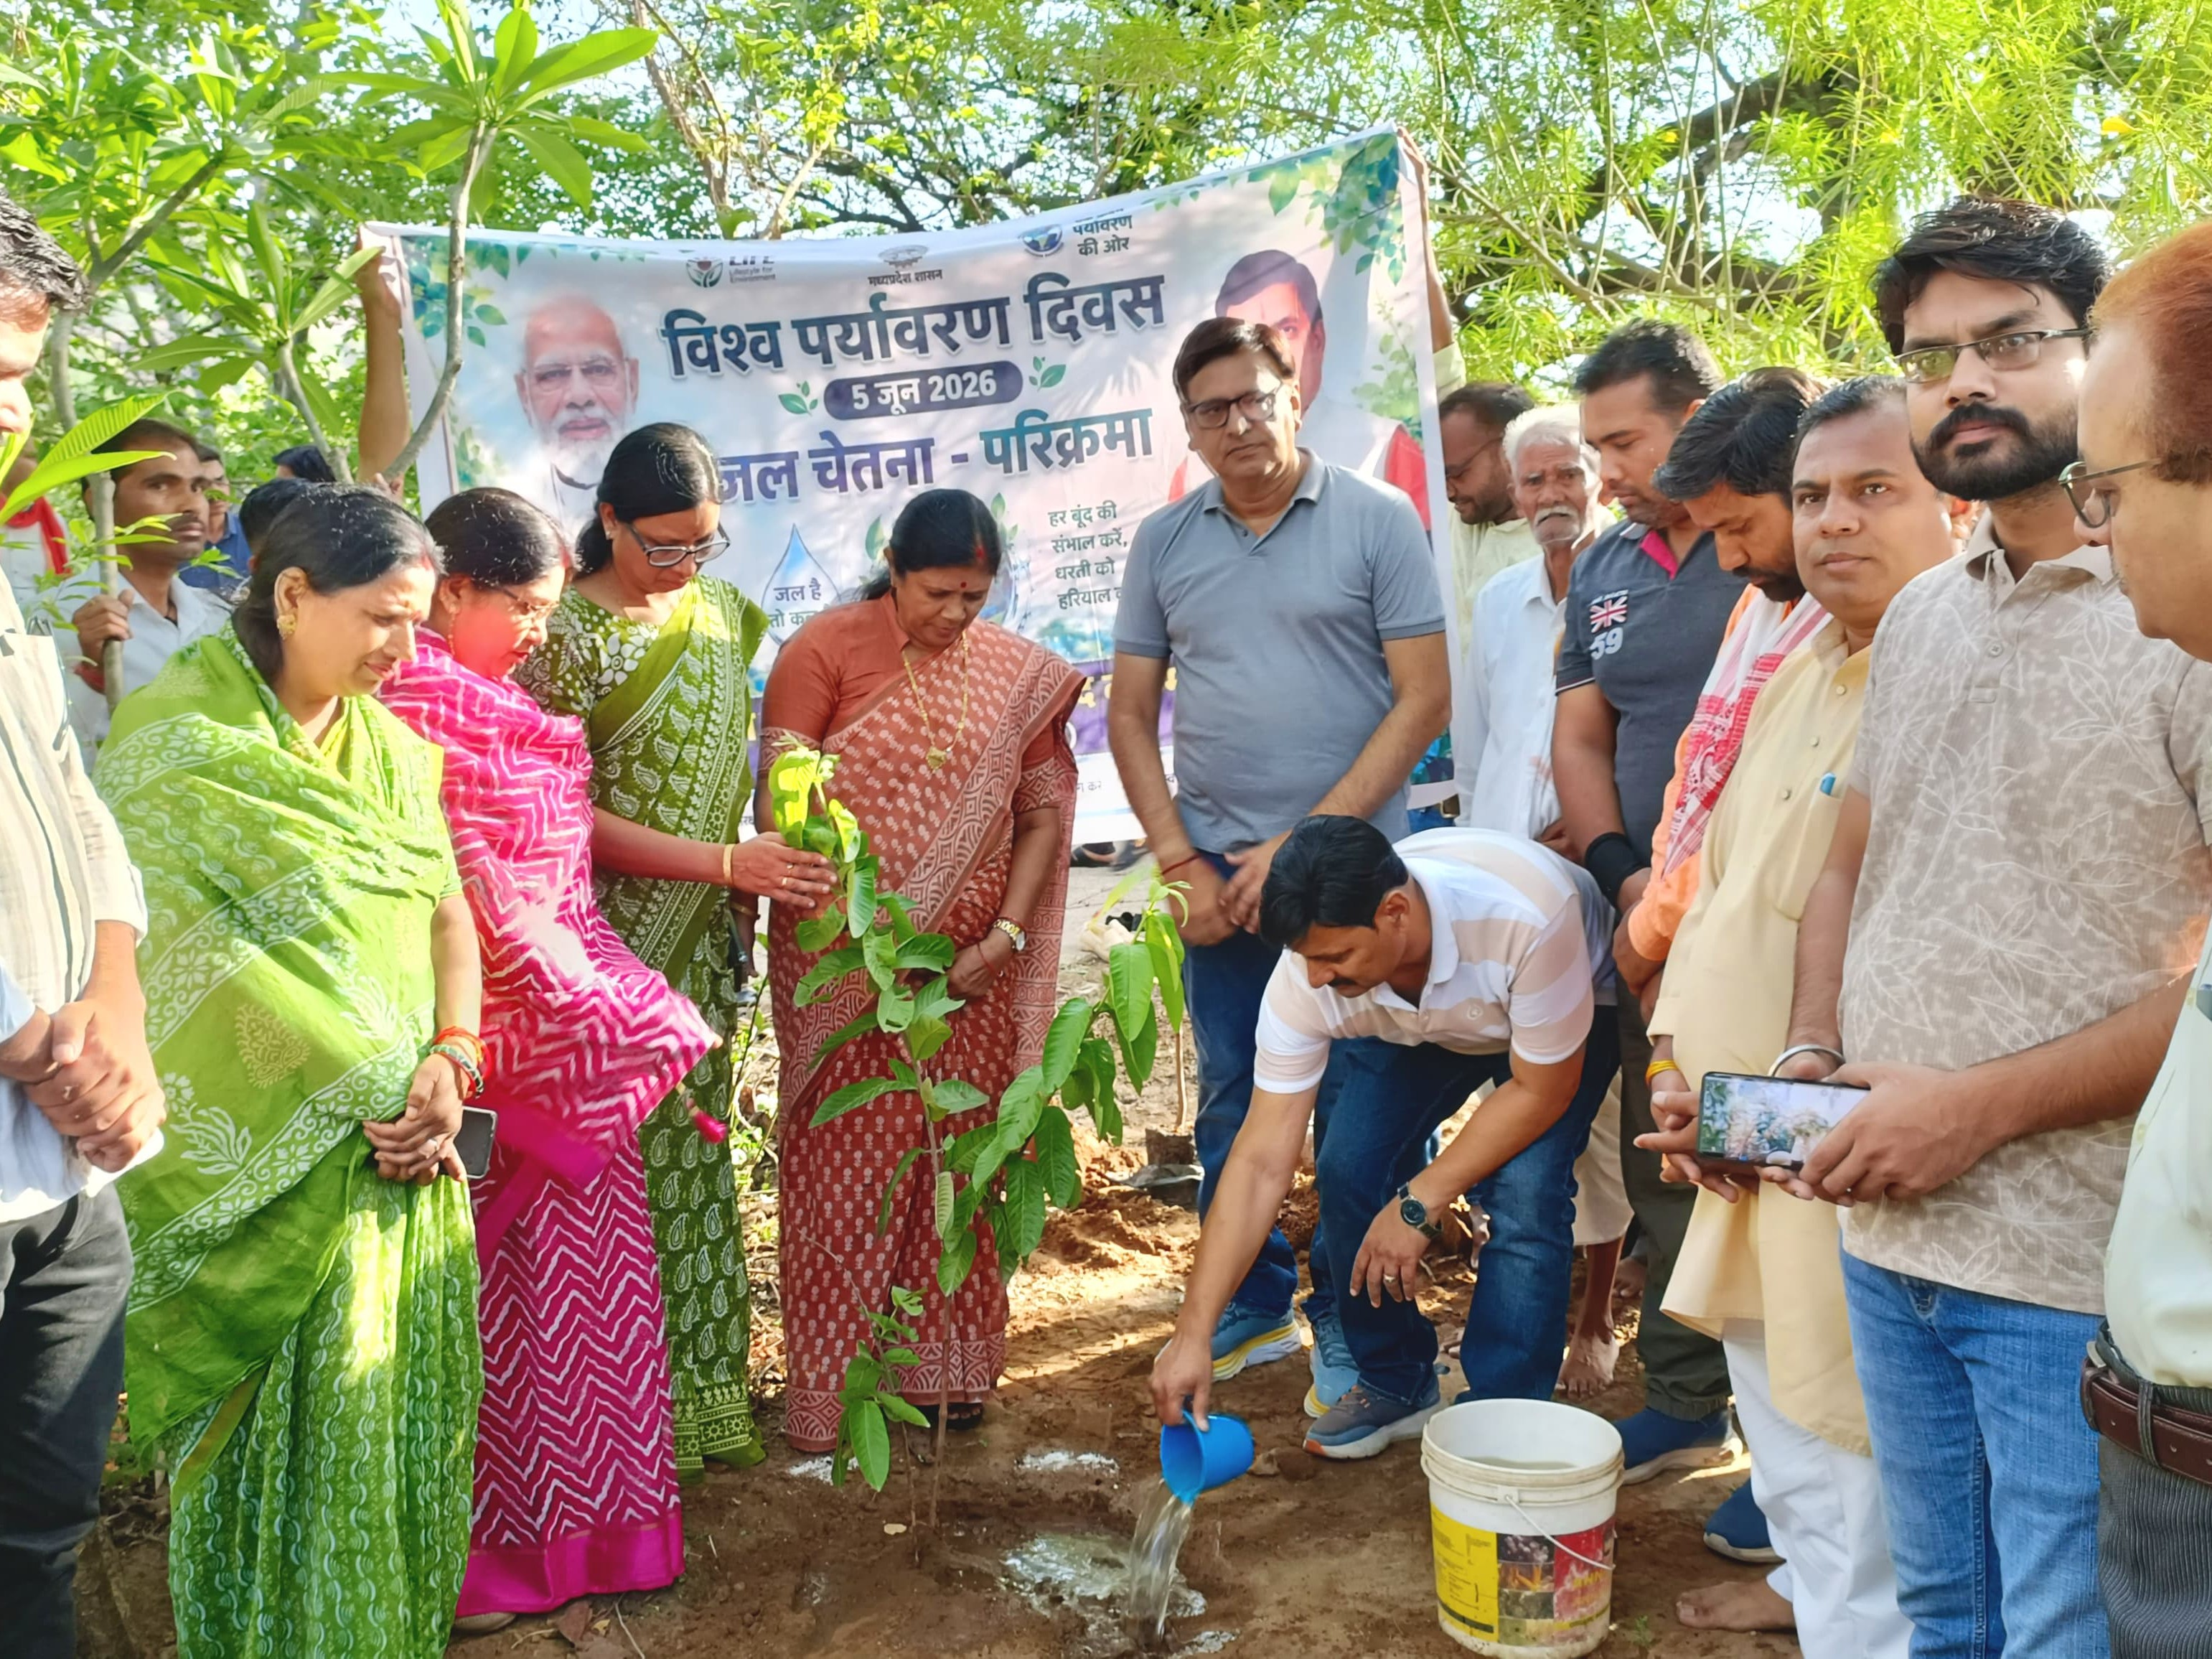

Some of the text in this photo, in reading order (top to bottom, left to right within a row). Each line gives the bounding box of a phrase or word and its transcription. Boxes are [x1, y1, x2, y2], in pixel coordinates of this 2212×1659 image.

[1077, 238, 1098, 256] की
[1104, 234, 1130, 253] ओर
[915, 268, 943, 283] शासन
[660, 271, 1165, 375] विश्व पर्यावरण दिवस
[851, 369, 997, 415] 5 जून 2026
[718, 451, 799, 502] जल
[808, 430, 934, 493] चेतना
[979, 408, 1153, 475] परिक्रमा
[1048, 500, 1117, 528] हर बूंद की
[1051, 528, 1128, 553] संभाल करें,
[1055, 556, 1115, 580] धरती को
[774, 577, 822, 602] जल है
[1057, 587, 1111, 609] हरियाल
[768, 609, 785, 628] तो
[1589, 627, 1623, 660] 59
